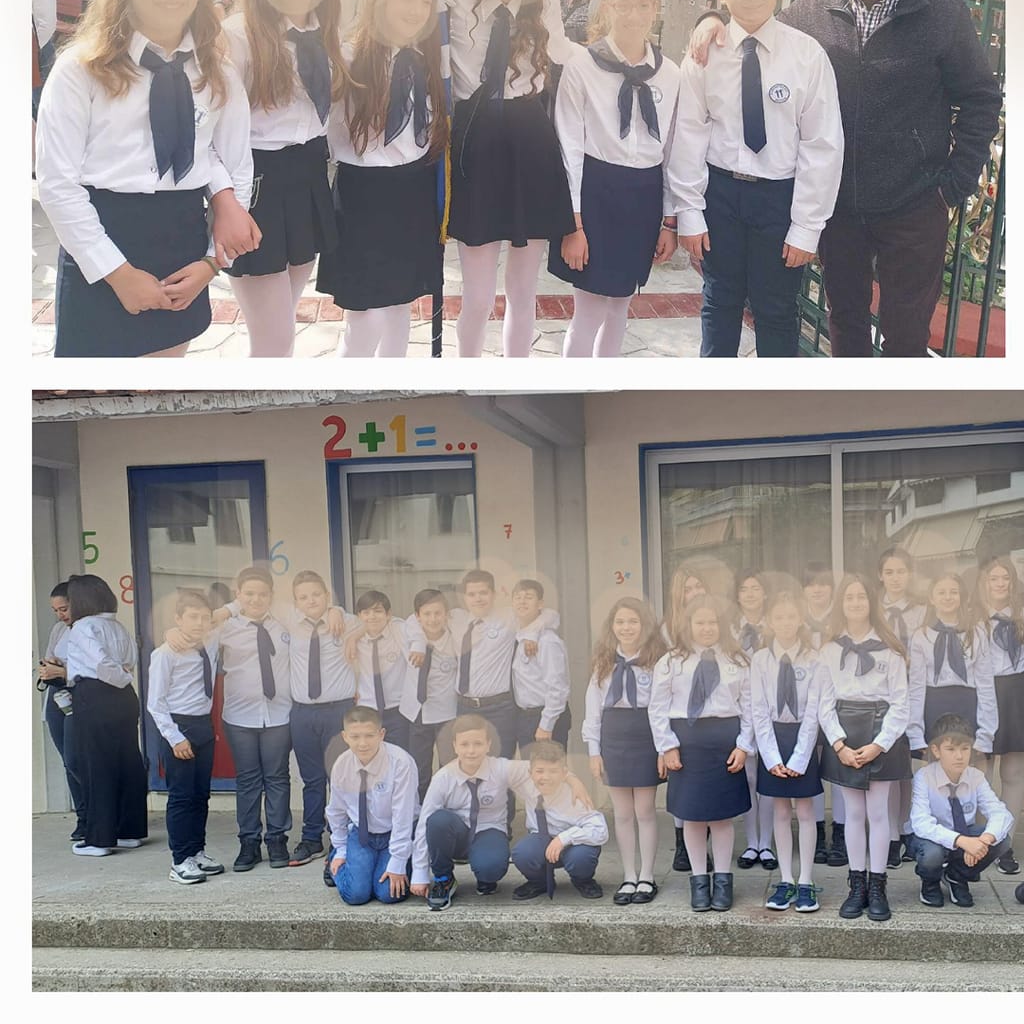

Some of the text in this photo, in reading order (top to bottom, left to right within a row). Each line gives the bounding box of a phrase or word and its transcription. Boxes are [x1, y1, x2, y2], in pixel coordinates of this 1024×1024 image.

[82, 531, 100, 564] 5
[503, 524, 513, 539] 7
[269, 540, 289, 576] 6
